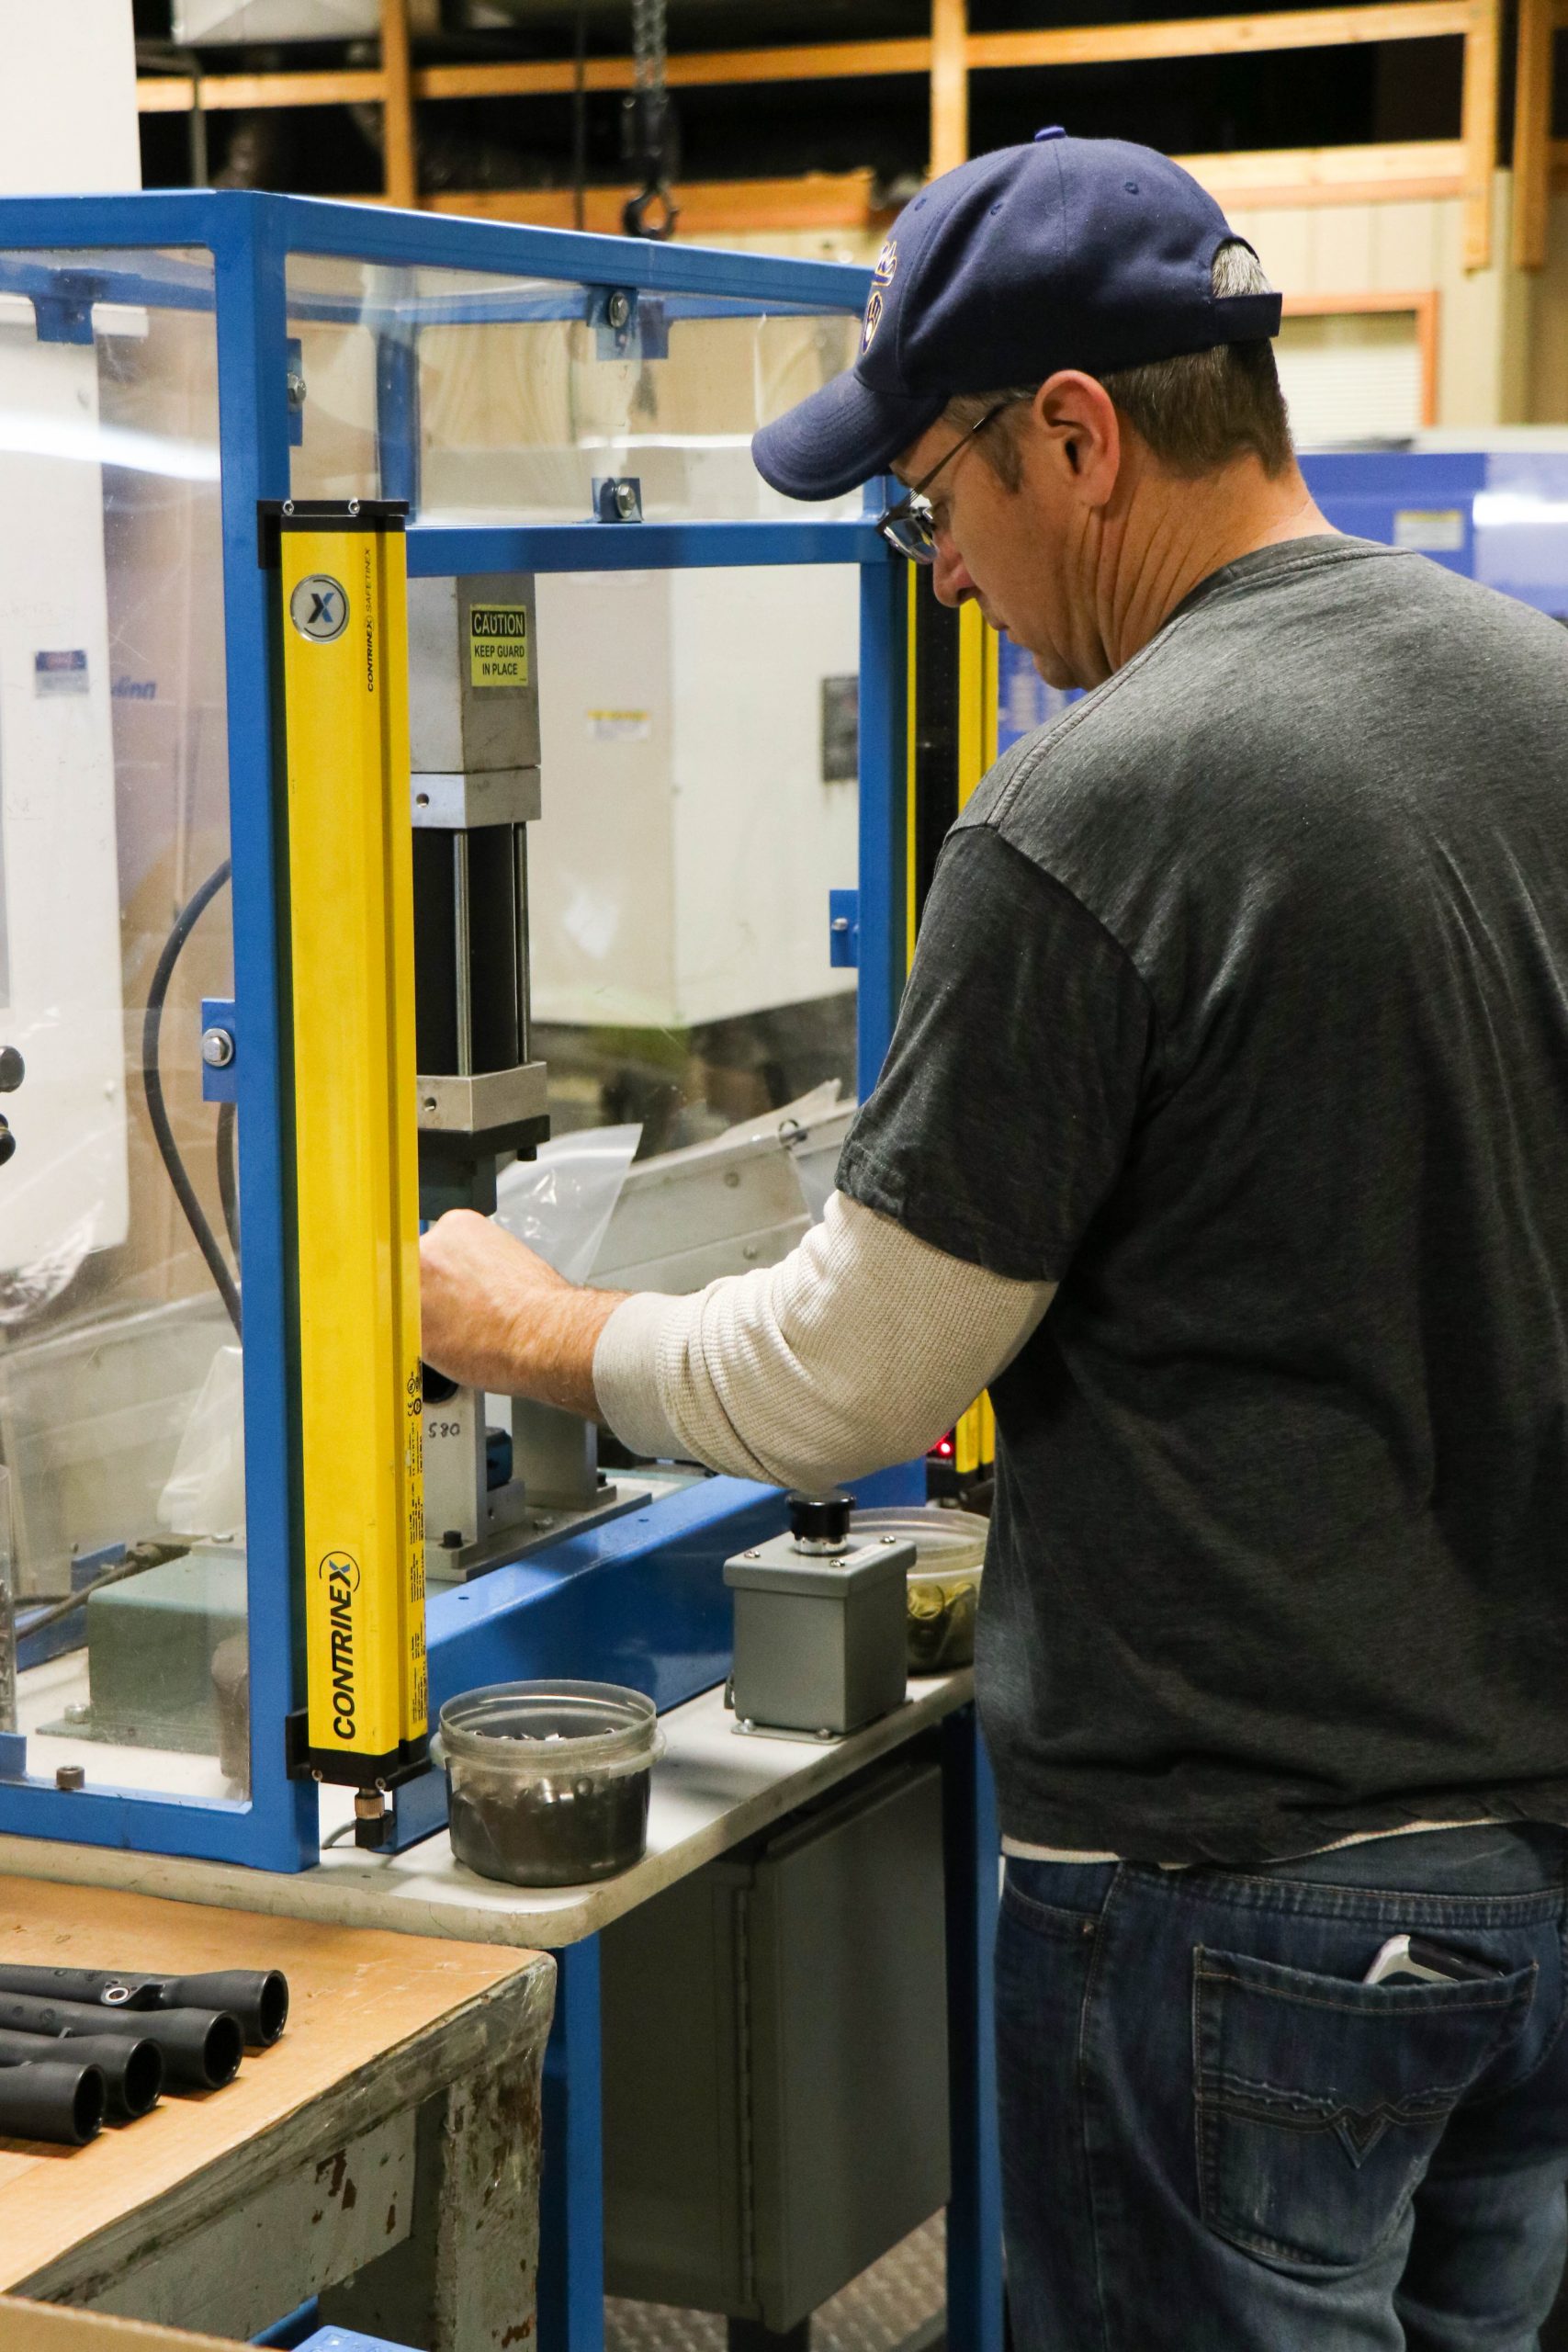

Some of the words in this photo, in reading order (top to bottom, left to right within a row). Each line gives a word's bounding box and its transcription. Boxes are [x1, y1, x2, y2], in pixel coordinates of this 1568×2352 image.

[364, 548, 372, 614] SAFETINEX
[474, 613, 524, 635] CAUTION
[366, 616, 374, 692] CONTRINEX
[474, 645, 495, 658] KEEP
[497, 645, 525, 658] GUARD
[482, 662, 491, 675] IN
[492, 662, 518, 675] PLACE
[328, 1559, 356, 1740] CONTRINEX
